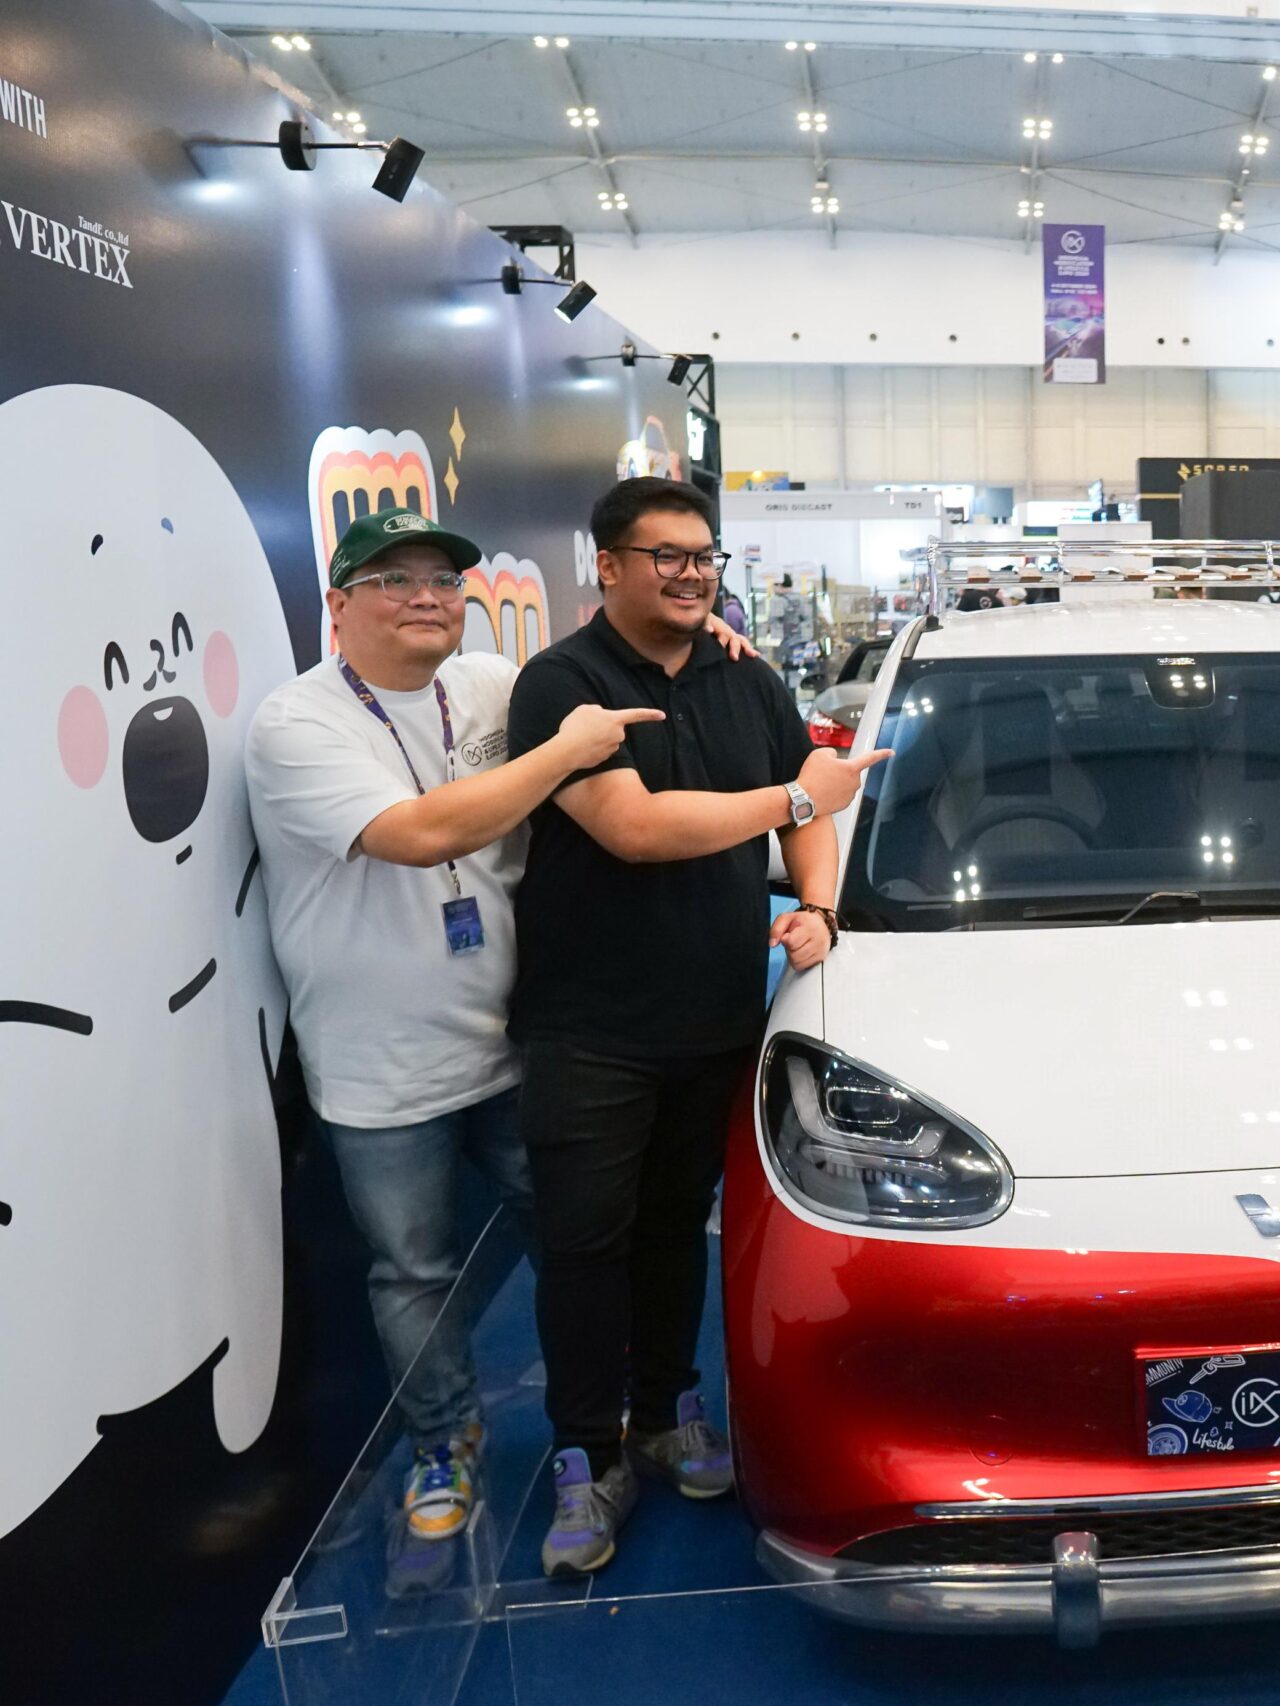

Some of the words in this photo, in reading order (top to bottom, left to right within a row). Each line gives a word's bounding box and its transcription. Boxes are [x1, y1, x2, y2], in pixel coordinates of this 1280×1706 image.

[0, 77, 47, 139] WITH
[1, 201, 134, 288] VERTEX
[78, 215, 103, 235] TandE
